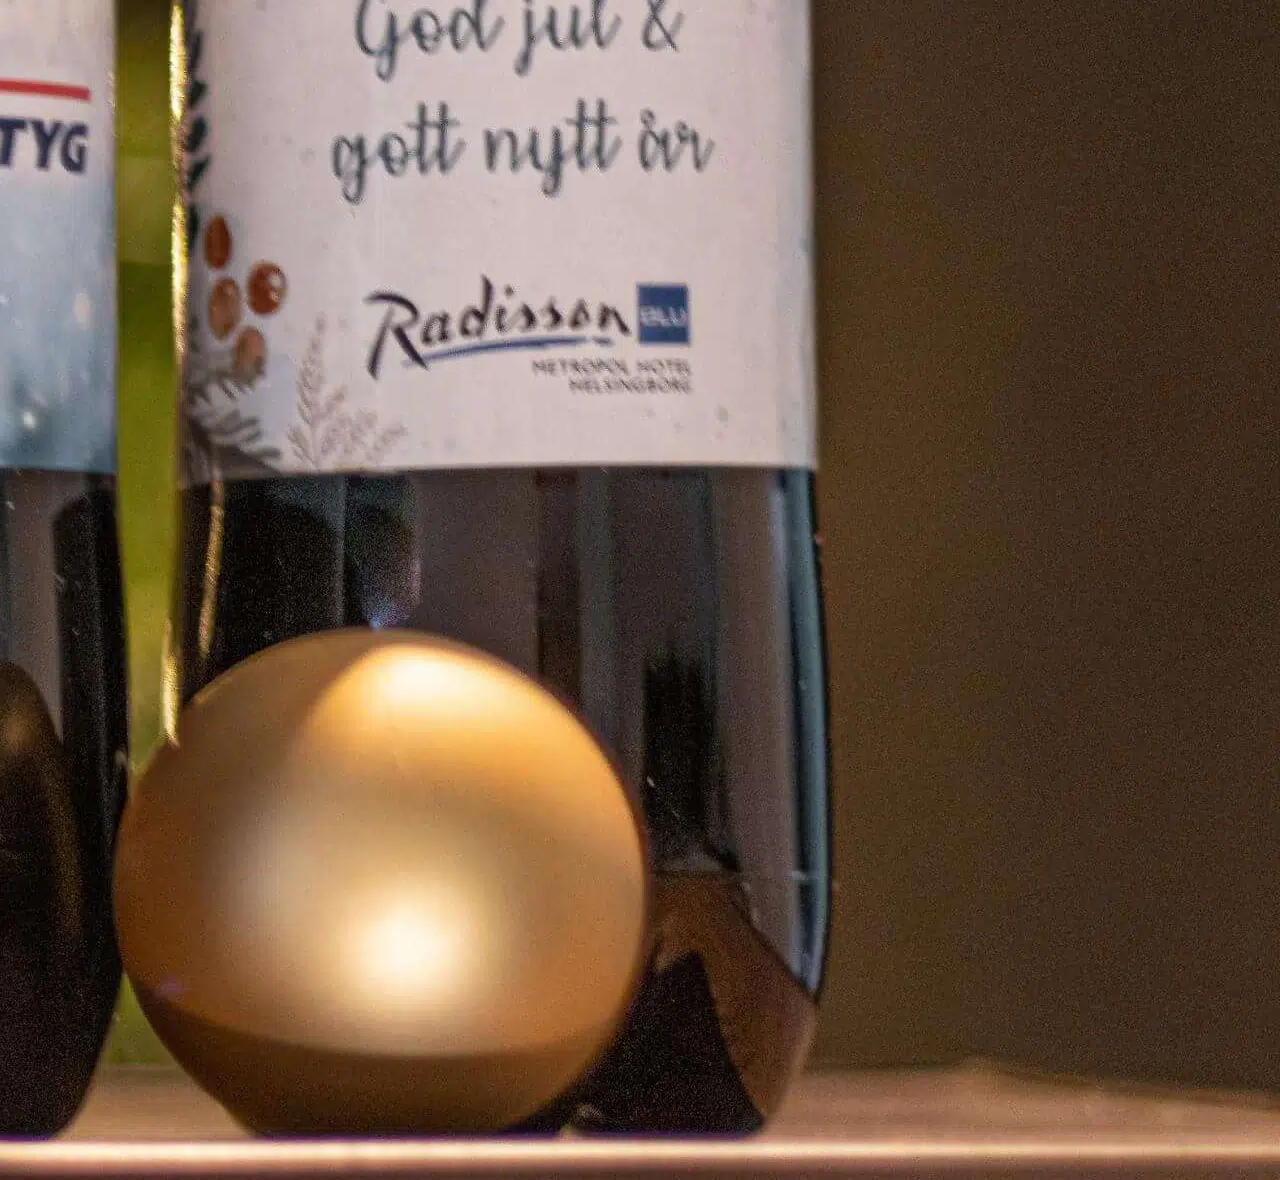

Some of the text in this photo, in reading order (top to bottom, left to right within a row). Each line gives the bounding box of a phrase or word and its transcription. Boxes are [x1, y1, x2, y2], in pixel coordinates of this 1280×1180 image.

[331, 97, 716, 205] gott nytt år
[364, 274, 633, 380] Radisson
